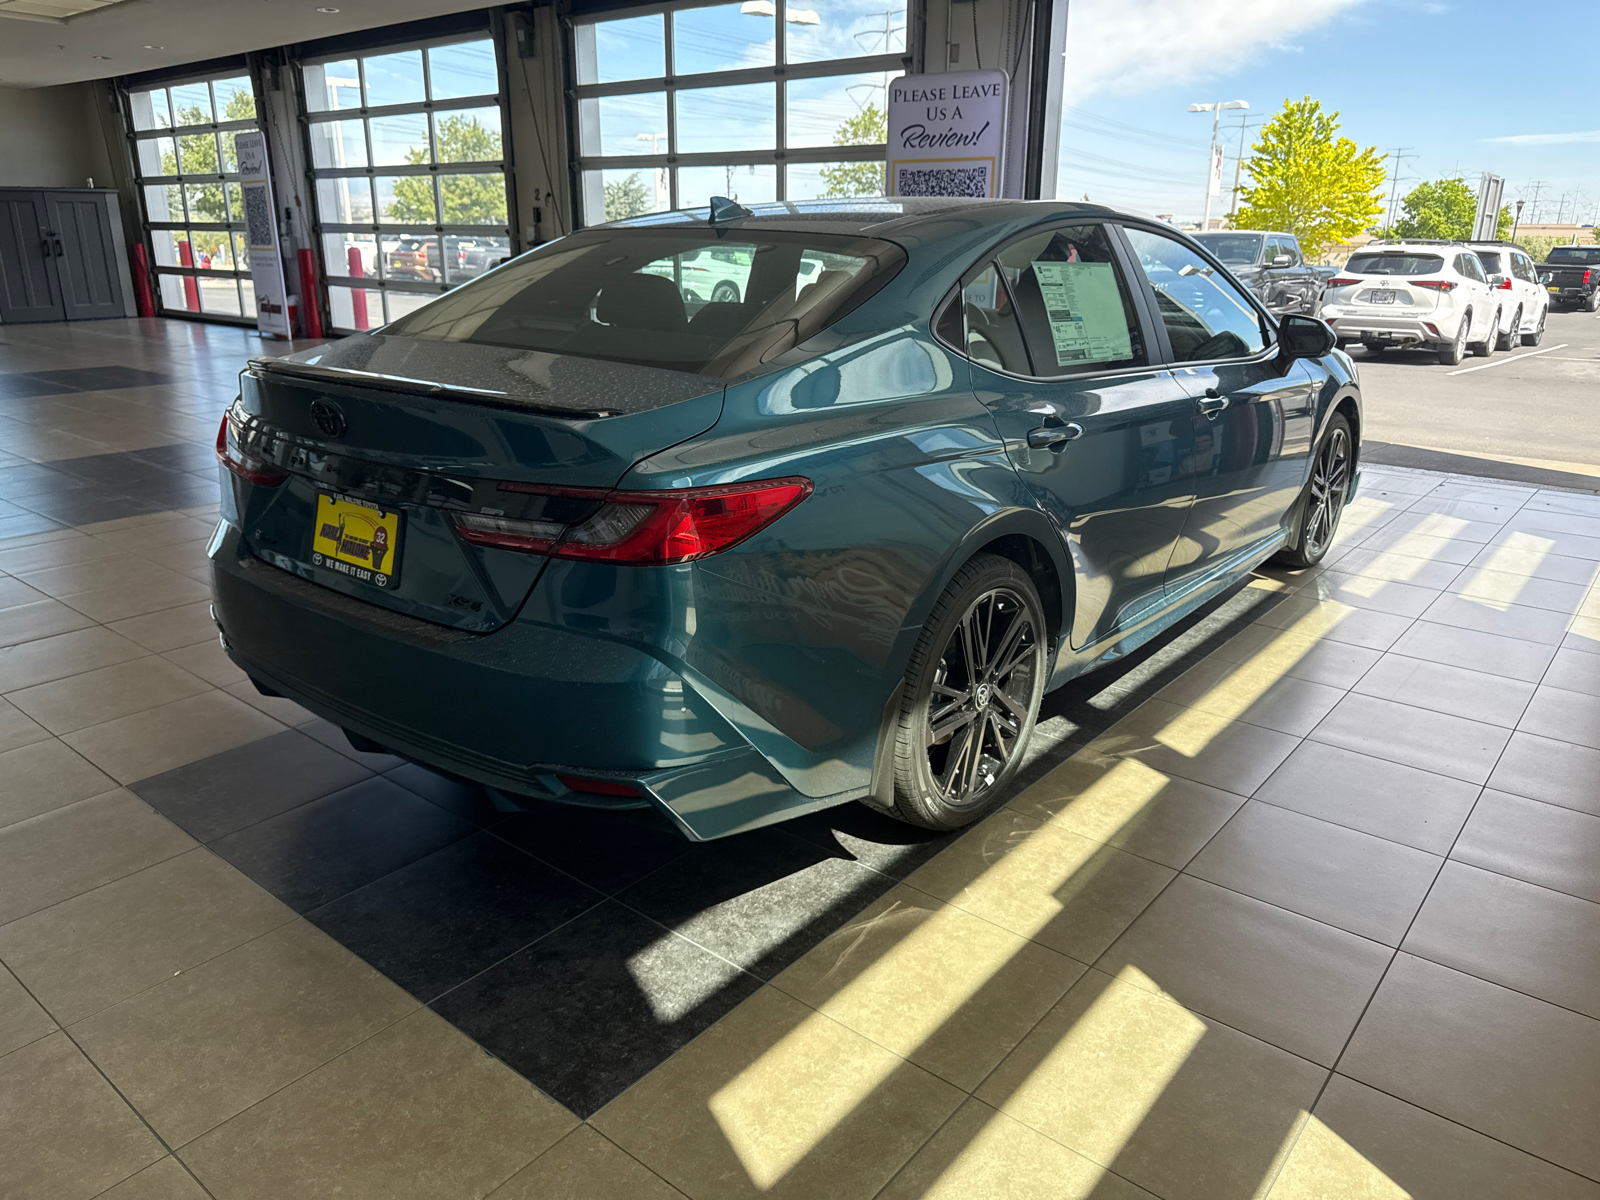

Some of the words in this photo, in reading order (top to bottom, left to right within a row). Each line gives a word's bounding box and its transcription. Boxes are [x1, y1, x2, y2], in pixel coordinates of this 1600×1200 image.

[893, 88, 946, 103] PLEASE
[952, 83, 1001, 99] LEAVE
[926, 106, 947, 121] US
[951, 106, 963, 119] A
[900, 120, 990, 149] Review!
[534, 188, 541, 201] 2
[974, 294, 986, 303] TO
[375, 531, 386, 544] 32
[325, 558, 334, 569] WE
[334, 561, 349, 575] MAKE
[350, 565, 357, 576] IT
[356, 568, 371, 581] EASY
